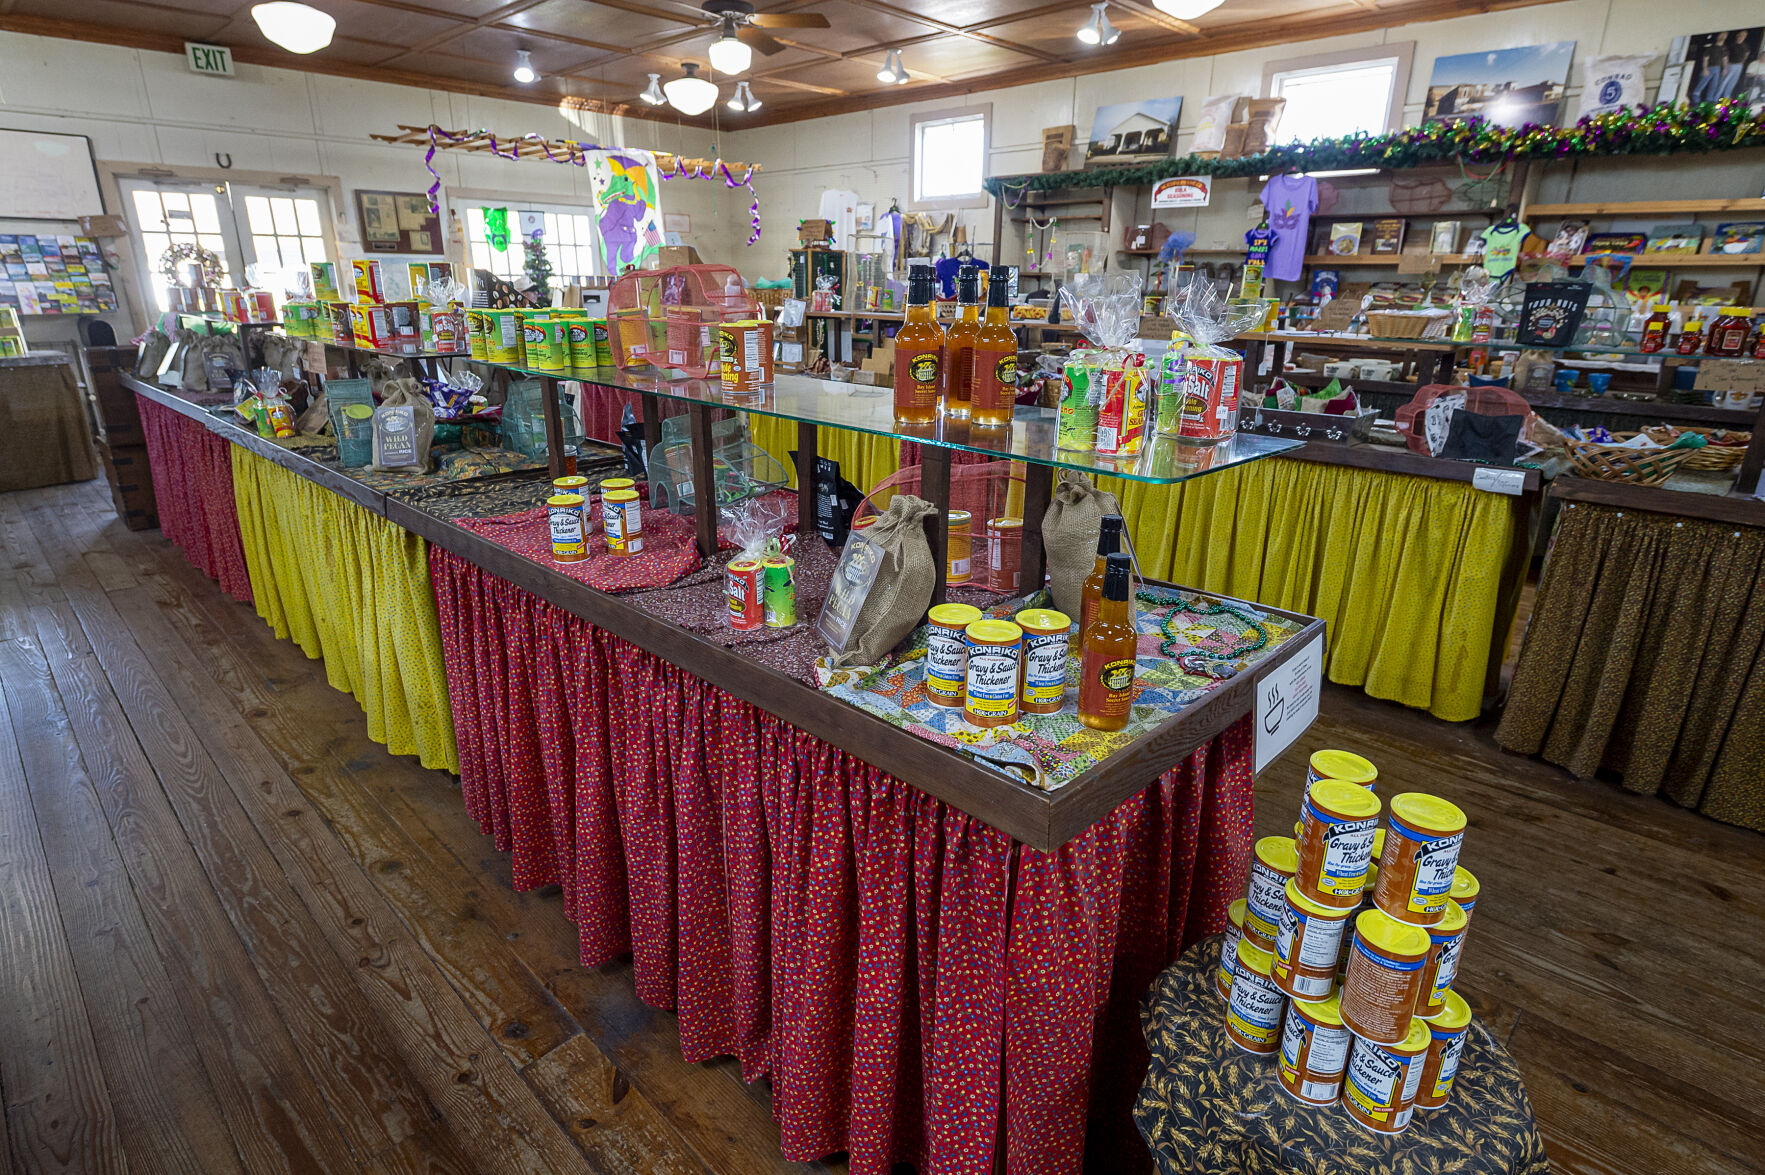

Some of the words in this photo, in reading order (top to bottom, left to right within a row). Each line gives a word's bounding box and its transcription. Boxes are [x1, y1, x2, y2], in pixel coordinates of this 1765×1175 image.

[191, 46, 227, 72] EXIT
[1606, 86, 1617, 100] 5
[1188, 374, 1210, 400] Salt
[385, 434, 408, 443] WILD
[384, 442, 411, 450] PECAN
[560, 518, 565, 526] &
[553, 526, 577, 534] Thickener
[730, 580, 746, 602] Salt
[835, 584, 856, 606] WILD
[828, 594, 852, 620] PECAN
[836, 616, 848, 630] RICE
[940, 644, 946, 654] &
[970, 646, 1018, 660] KONRIKO
[930, 652, 962, 666] Thickener
[1028, 651, 1053, 664] Gravy
[1053, 650, 1058, 661] &
[968, 660, 990, 676] Gravy
[990, 664, 996, 675] &
[996, 660, 1017, 674] Sauce
[975, 674, 1012, 686] Thickener
[1330, 838, 1361, 854] Gravy
[1361, 836, 1367, 850] &
[1422, 856, 1452, 868] Gravy
[1264, 884, 1272, 896] &
[1232, 977, 1250, 998] Gravy
[1250, 990, 1258, 1001] &
[1236, 993, 1274, 1015] Thickener
[1360, 1054, 1366, 1064] &
[1365, 1060, 1395, 1078] Sauce
